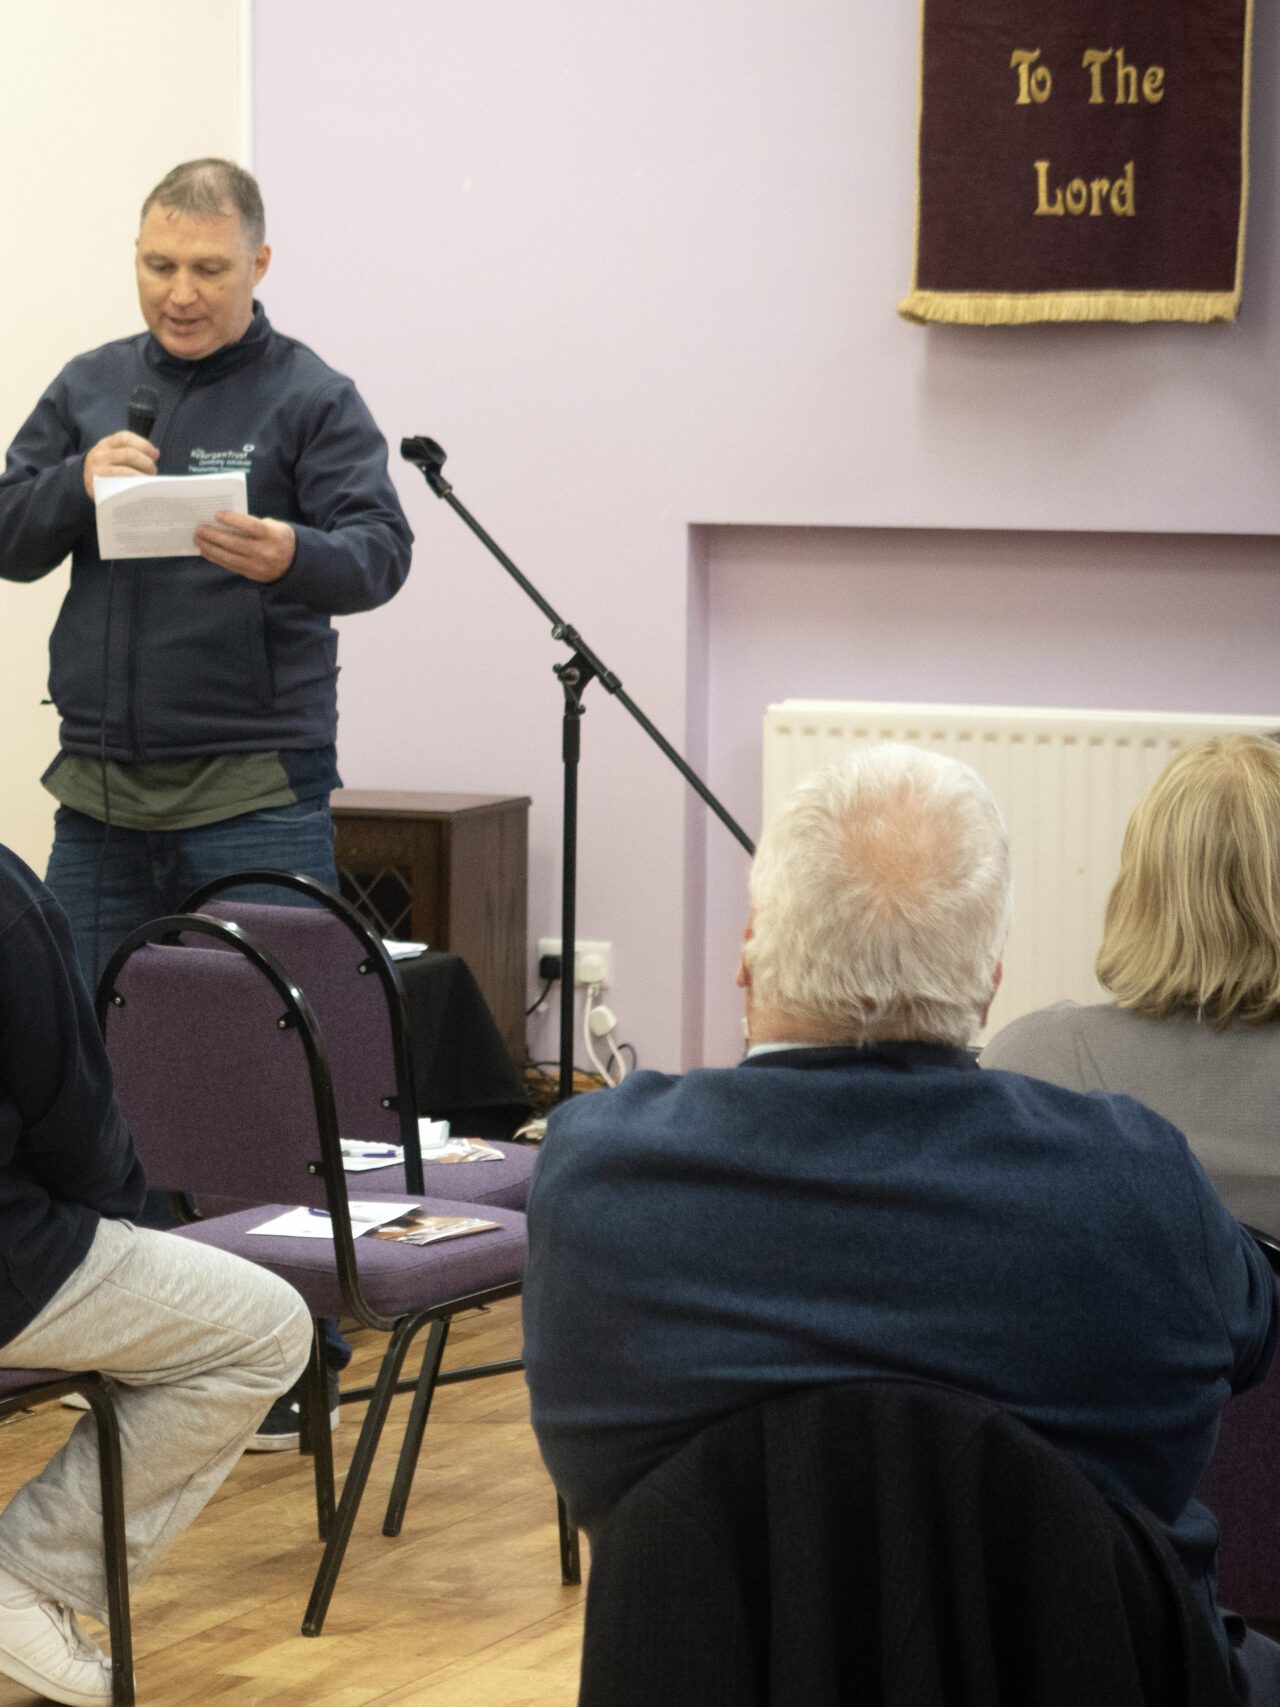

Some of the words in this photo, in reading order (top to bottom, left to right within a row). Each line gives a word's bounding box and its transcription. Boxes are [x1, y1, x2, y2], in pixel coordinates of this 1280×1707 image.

[1010, 47, 1052, 104] To
[1081, 46, 1165, 104] The
[1034, 160, 1136, 216] Lord
